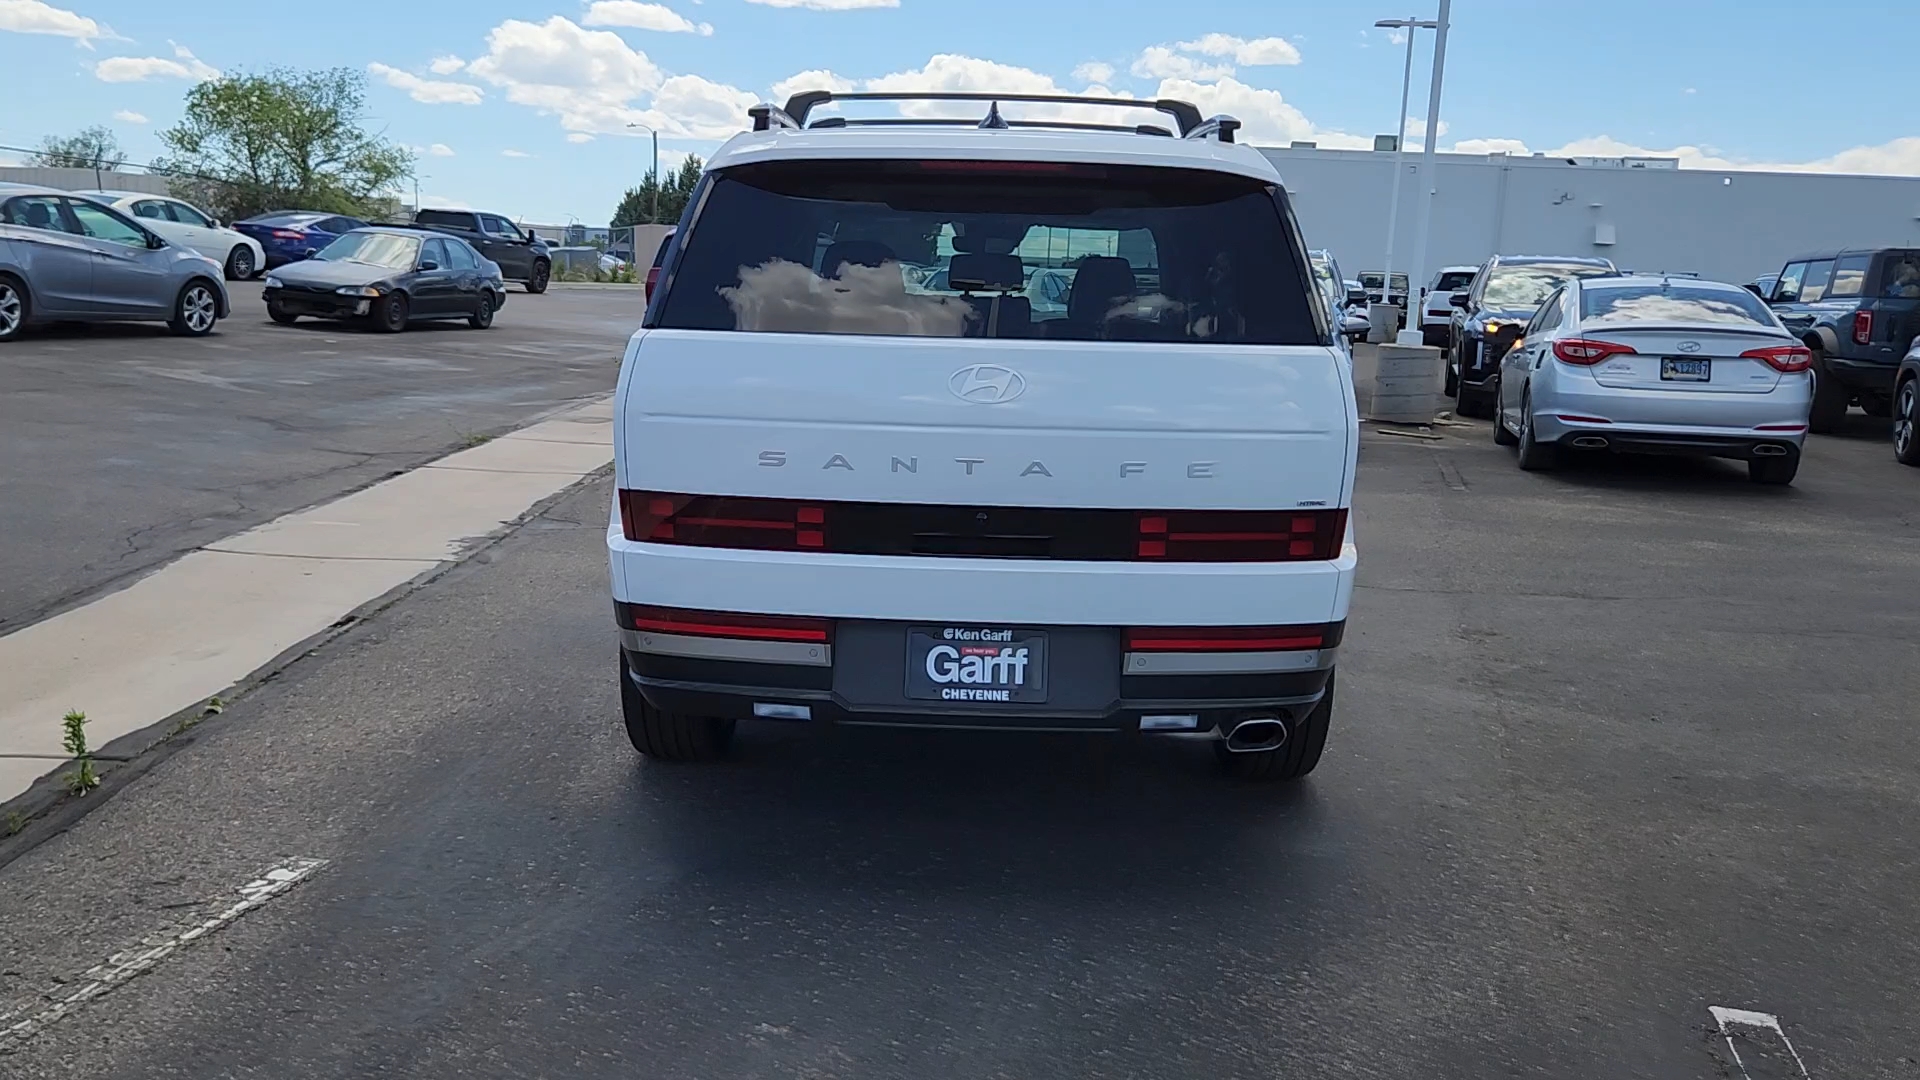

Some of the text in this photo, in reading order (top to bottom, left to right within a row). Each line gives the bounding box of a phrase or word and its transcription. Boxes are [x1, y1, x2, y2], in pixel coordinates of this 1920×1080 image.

[757, 450, 1219, 479] SANTA FE
[954, 628, 1013, 642] Ken Garff
[926, 645, 1029, 685] Garff
[941, 688, 1010, 701] CHEYENNE
